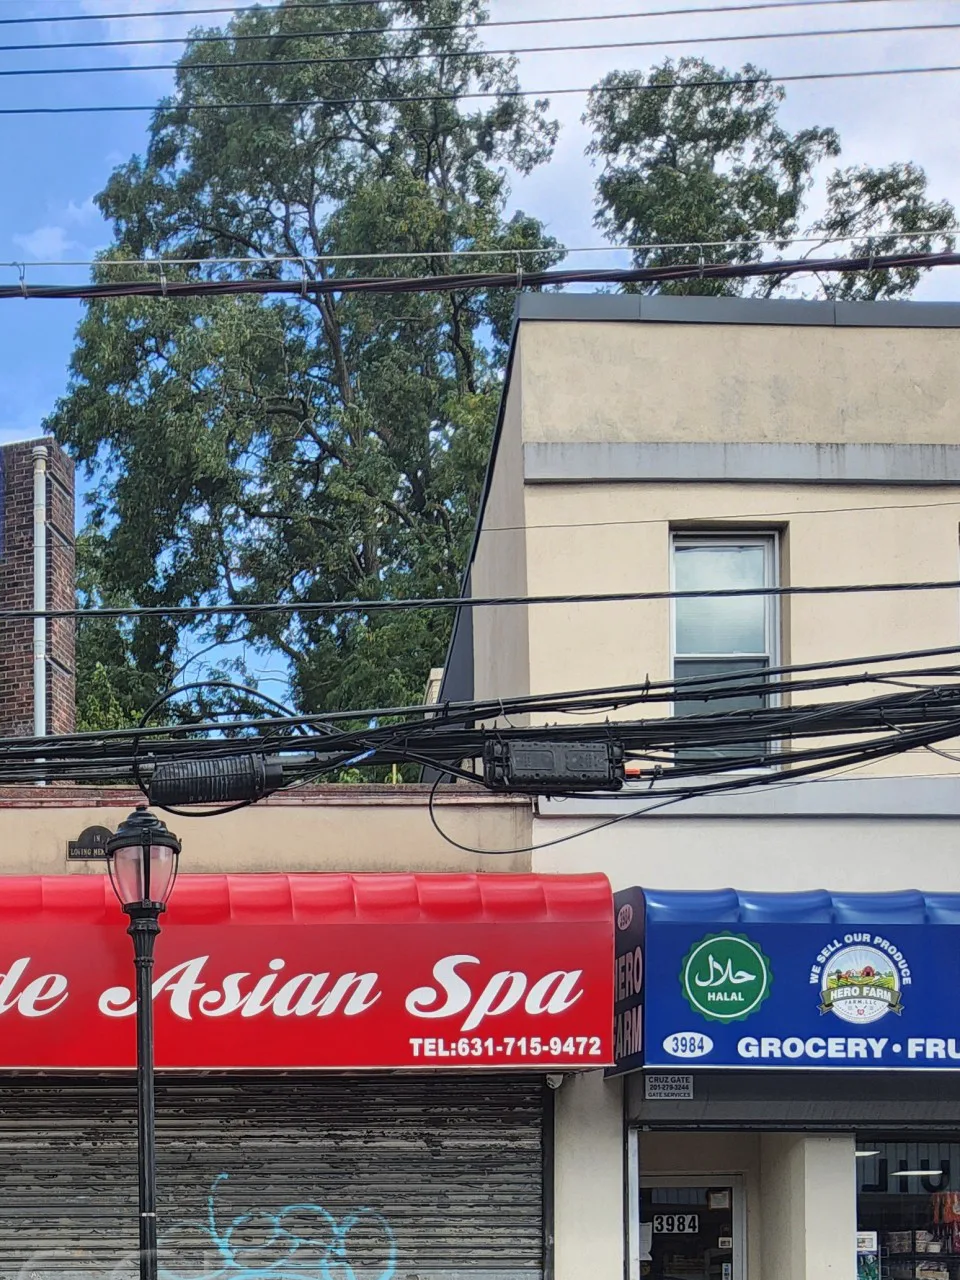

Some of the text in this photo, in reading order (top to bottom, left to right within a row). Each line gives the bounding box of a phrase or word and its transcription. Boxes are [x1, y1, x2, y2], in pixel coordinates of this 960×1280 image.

[809, 933, 912, 986] WE SELL OUR PRODUCE
[98, 955, 382, 1020] Asian
[405, 954, 584, 1032] Spa
[707, 992, 744, 1002] HALAL
[830, 986, 892, 1001] HERO FARM
[615, 1005, 642, 1060] ARM
[410, 1037, 601, 1057] TEL:631-715-9472
[672, 1037, 705, 1054] 3984
[737, 1036, 889, 1059] GROCERY
[648, 1076, 691, 1084] CRUZ GATE
[654, 1215, 698, 1232] 3984
